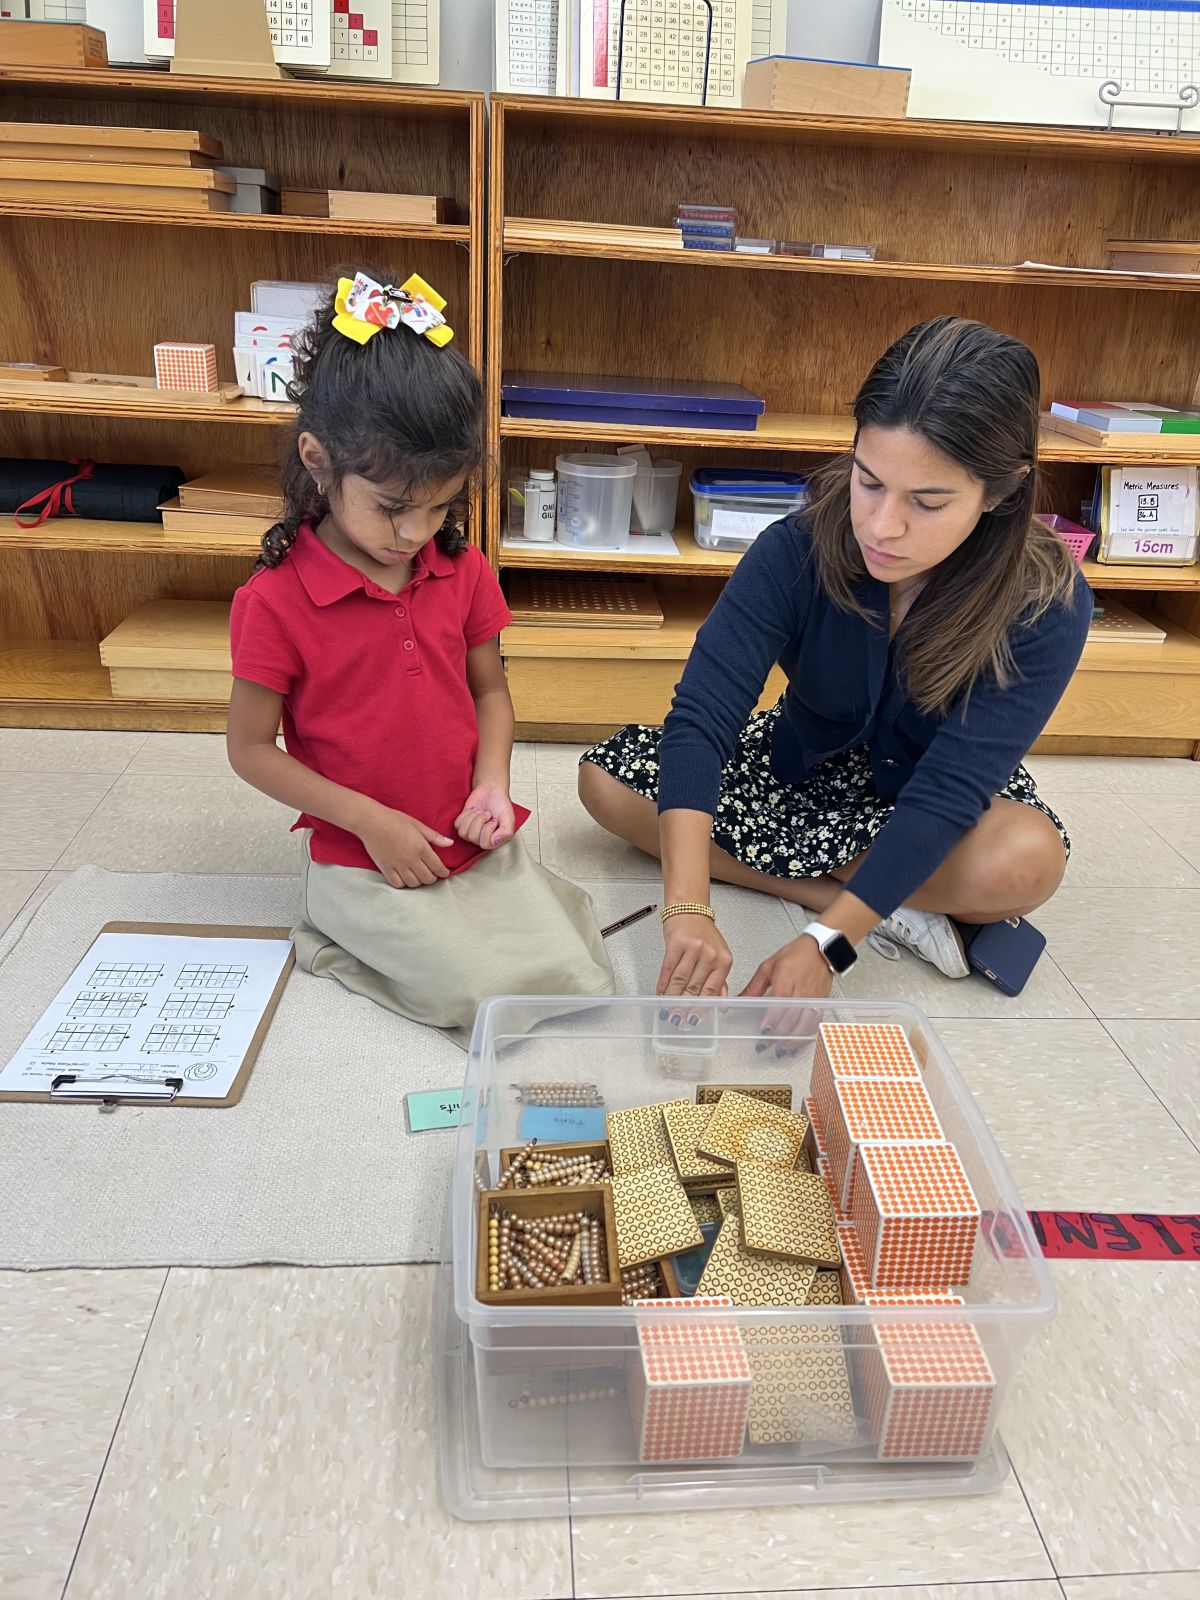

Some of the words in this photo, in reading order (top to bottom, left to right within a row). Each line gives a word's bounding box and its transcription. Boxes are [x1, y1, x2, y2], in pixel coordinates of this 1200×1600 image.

[1123, 482, 1143, 490] Metric
[1146, 482, 1179, 490] Measures
[1134, 540, 1174, 554] 15cm
